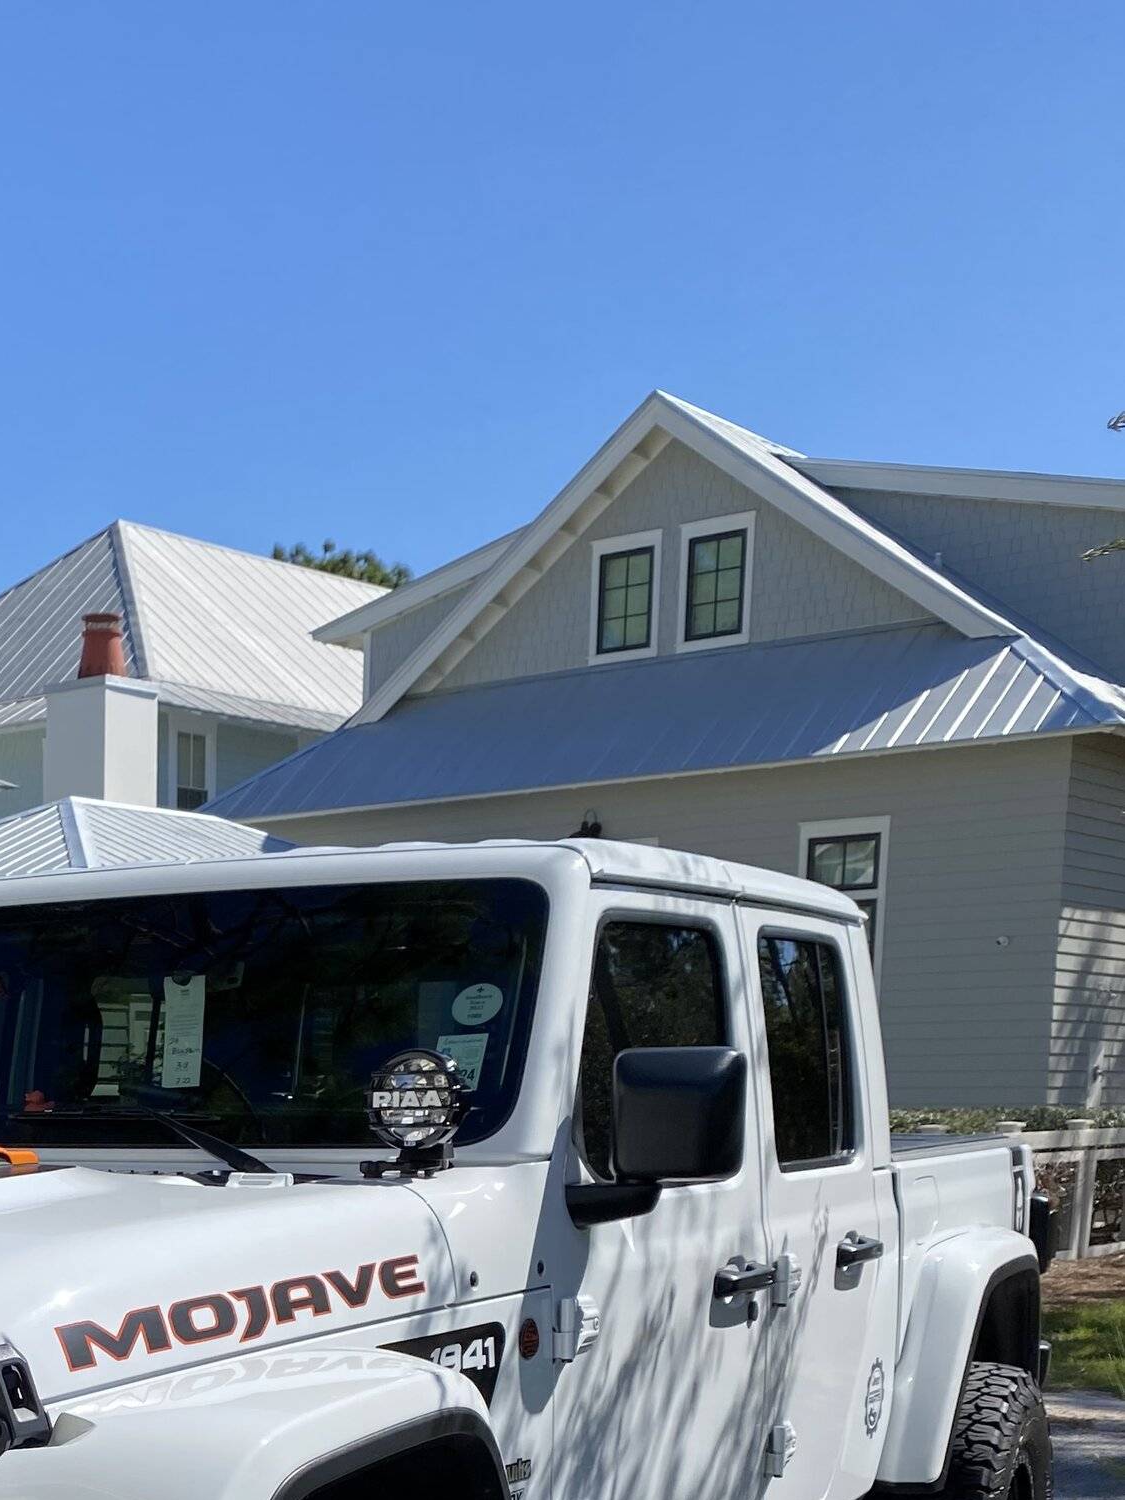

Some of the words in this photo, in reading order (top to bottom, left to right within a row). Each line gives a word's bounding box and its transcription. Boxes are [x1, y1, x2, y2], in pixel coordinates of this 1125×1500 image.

[372, 1090, 442, 1108] PIAA
[54, 1254, 426, 1372] MOJAVE
[430, 1336, 495, 1372] 1941
